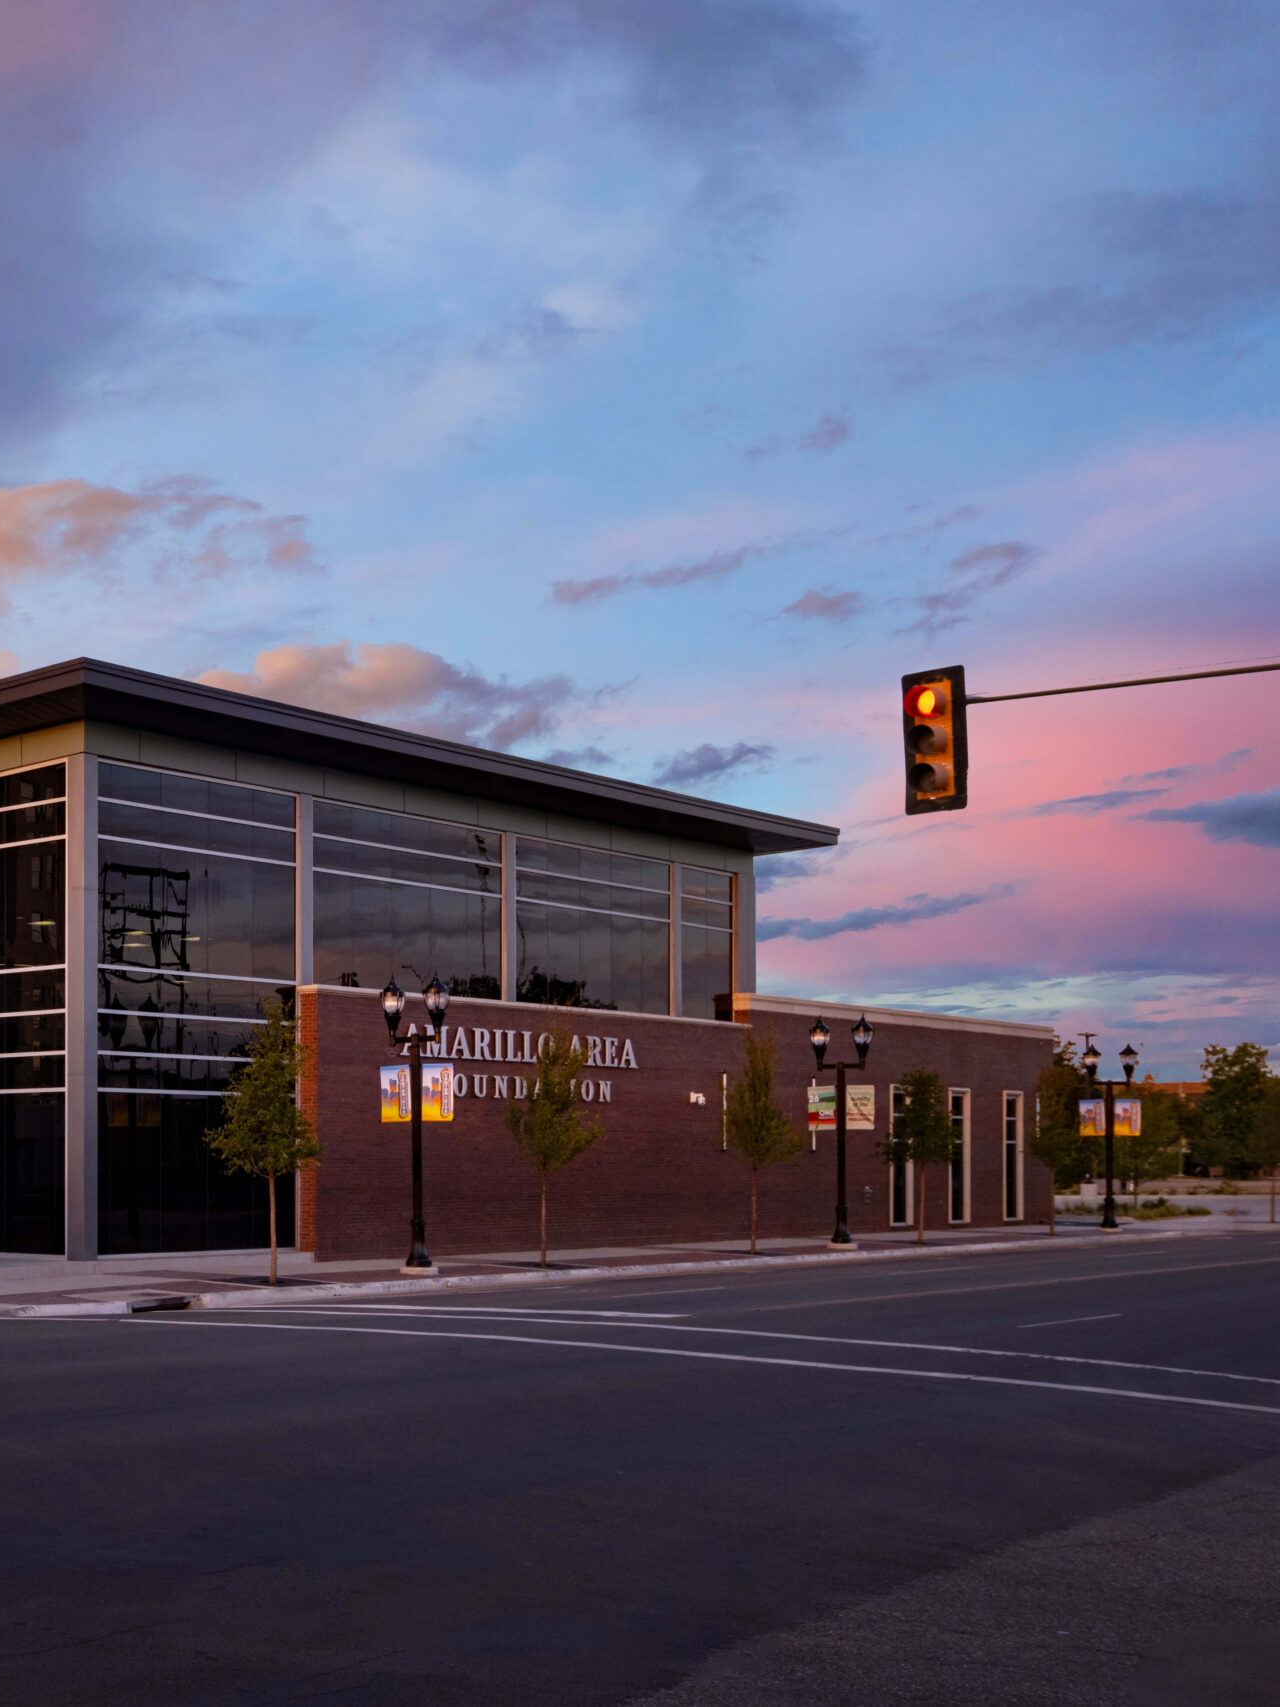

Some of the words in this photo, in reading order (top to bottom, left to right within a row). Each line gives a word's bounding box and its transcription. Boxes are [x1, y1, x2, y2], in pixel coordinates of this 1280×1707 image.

[400, 1023, 556, 1064] AMARILLO
[567, 1034, 639, 1069] AREA
[453, 1073, 612, 1103] OUNDION
